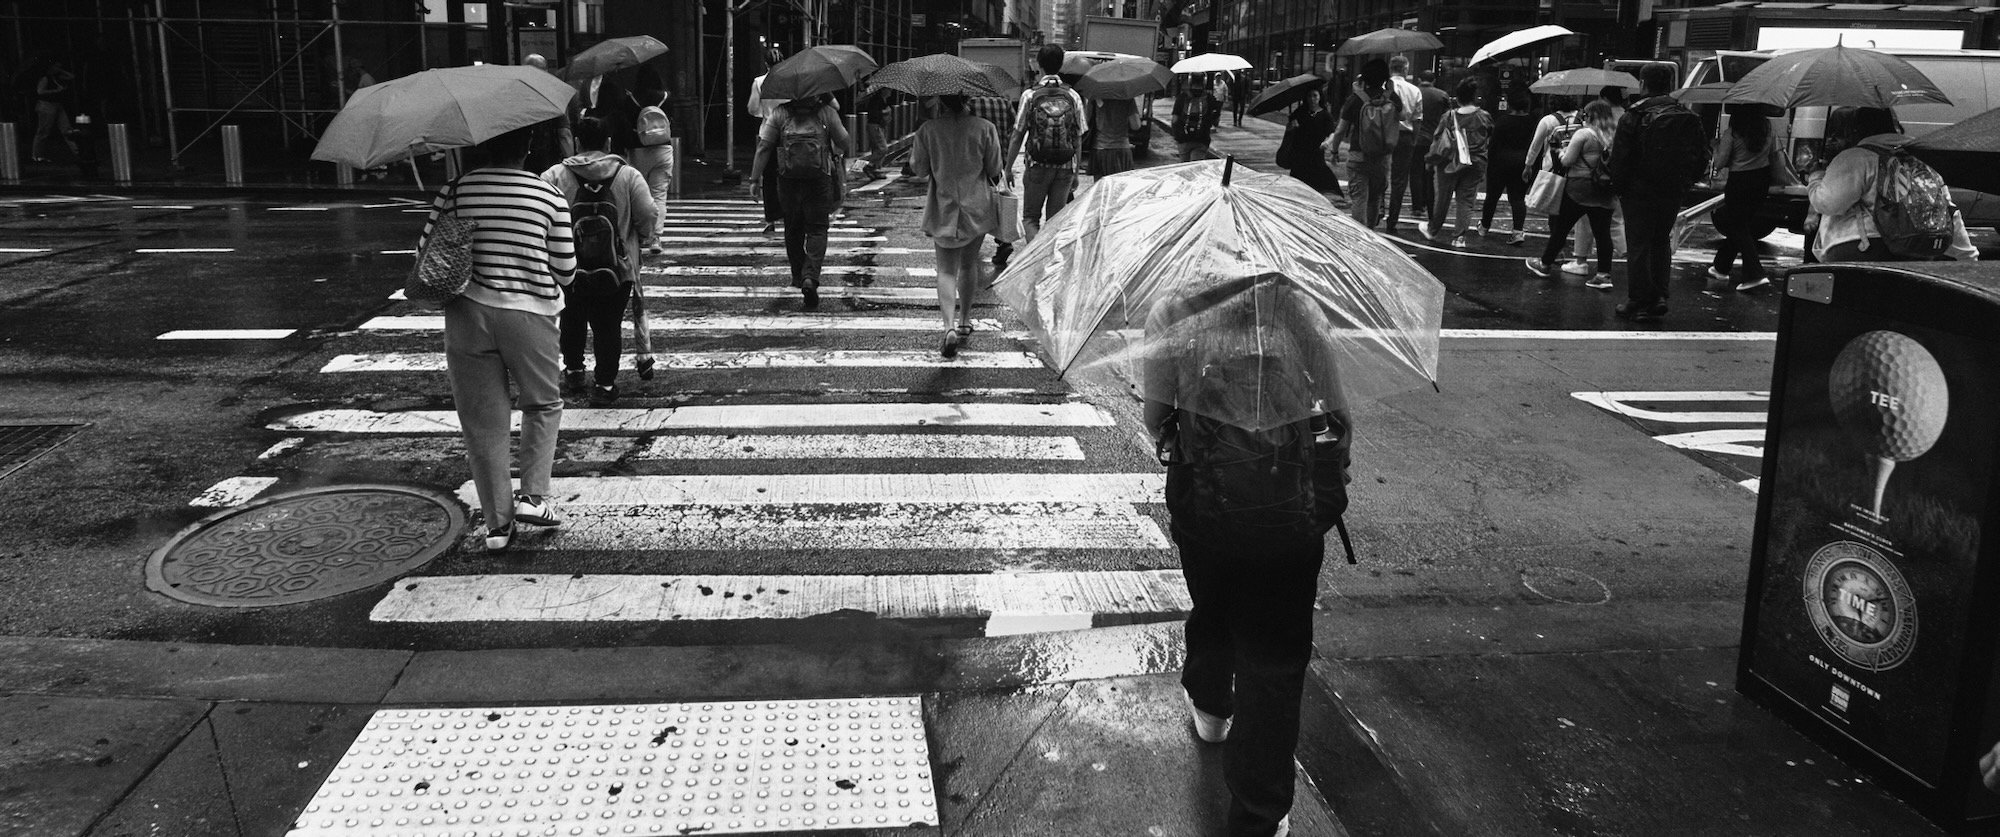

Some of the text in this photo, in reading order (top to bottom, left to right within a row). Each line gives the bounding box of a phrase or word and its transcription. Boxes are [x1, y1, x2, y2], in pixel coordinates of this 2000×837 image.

[1870, 390, 1900, 410] TEE
[1838, 588, 1878, 616] TIME
[1808, 654, 1830, 670] ONLY
[1831, 666, 1881, 701] DOWNTOWN
